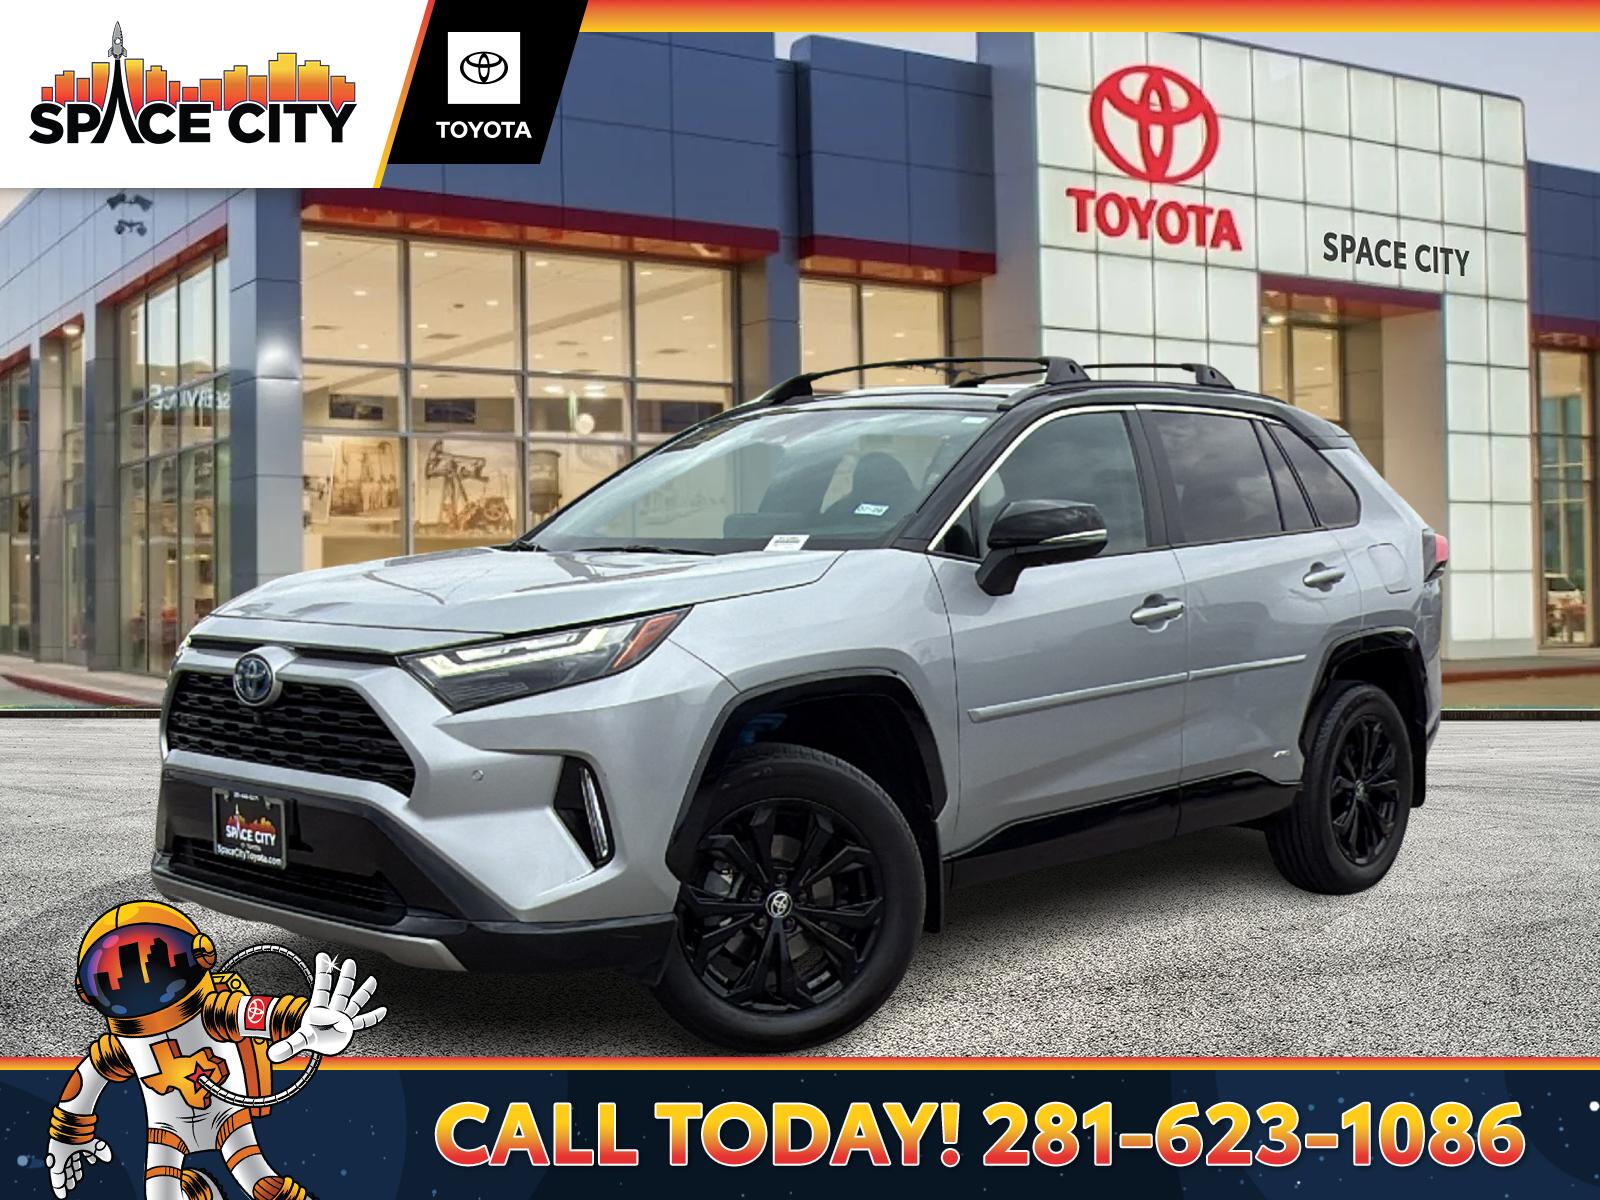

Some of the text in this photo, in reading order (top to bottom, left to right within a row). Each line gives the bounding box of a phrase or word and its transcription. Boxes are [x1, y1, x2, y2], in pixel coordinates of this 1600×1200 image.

[1066, 188, 1243, 252] TOYOTA
[1322, 232, 1471, 277] SPACE CITY
[225, 822, 276, 846] SPACE CITY
